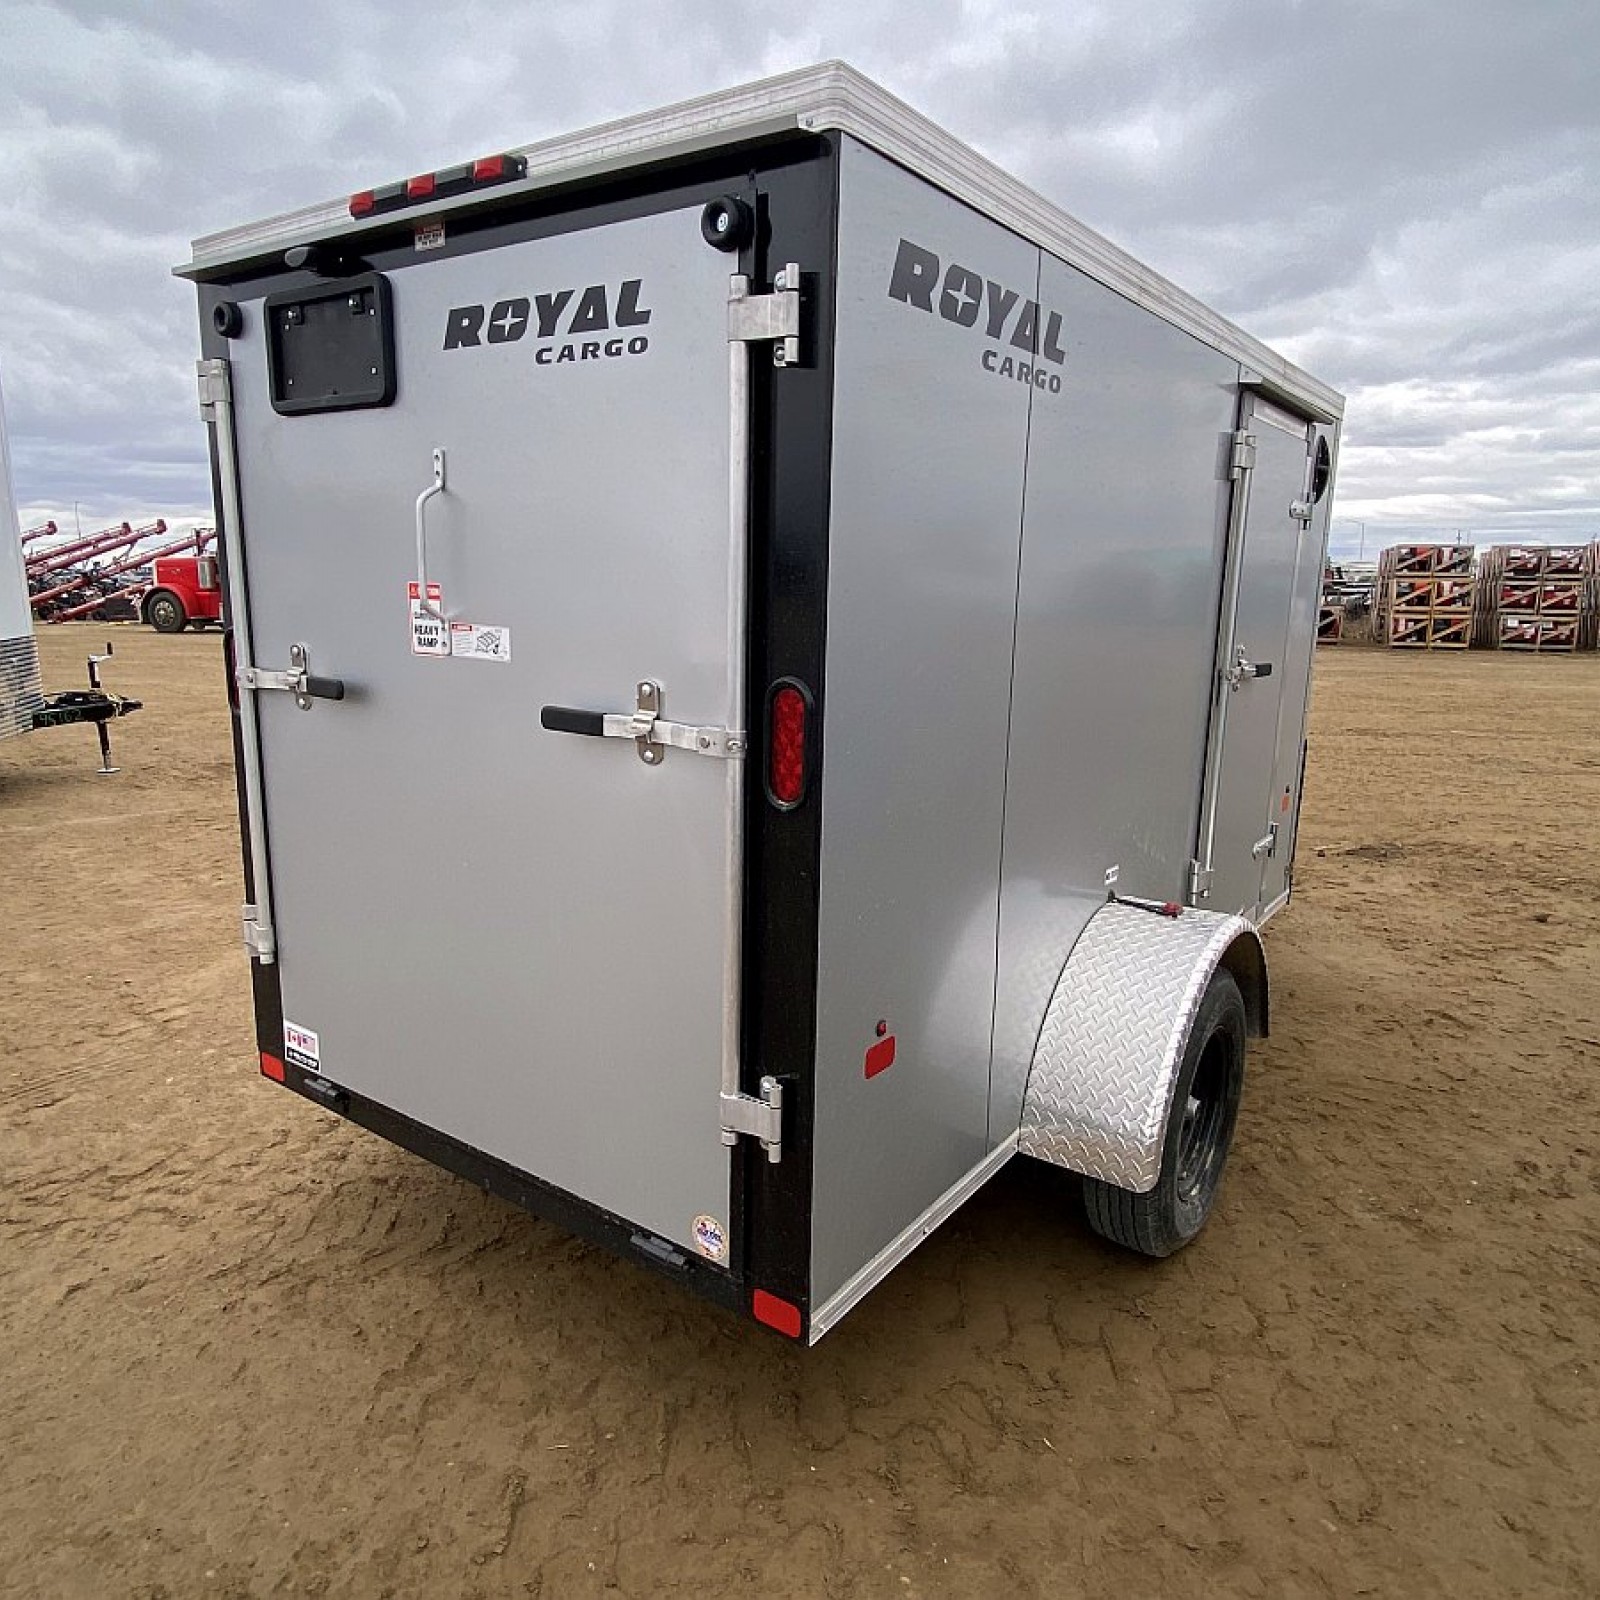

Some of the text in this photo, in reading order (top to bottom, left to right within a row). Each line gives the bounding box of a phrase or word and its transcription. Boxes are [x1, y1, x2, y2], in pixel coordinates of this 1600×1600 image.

[443, 279, 652, 350] ROYAL
[889, 238, 1066, 365] ROYAL
[535, 336, 650, 365] CARGO
[981, 350, 1062, 393] CARGO
